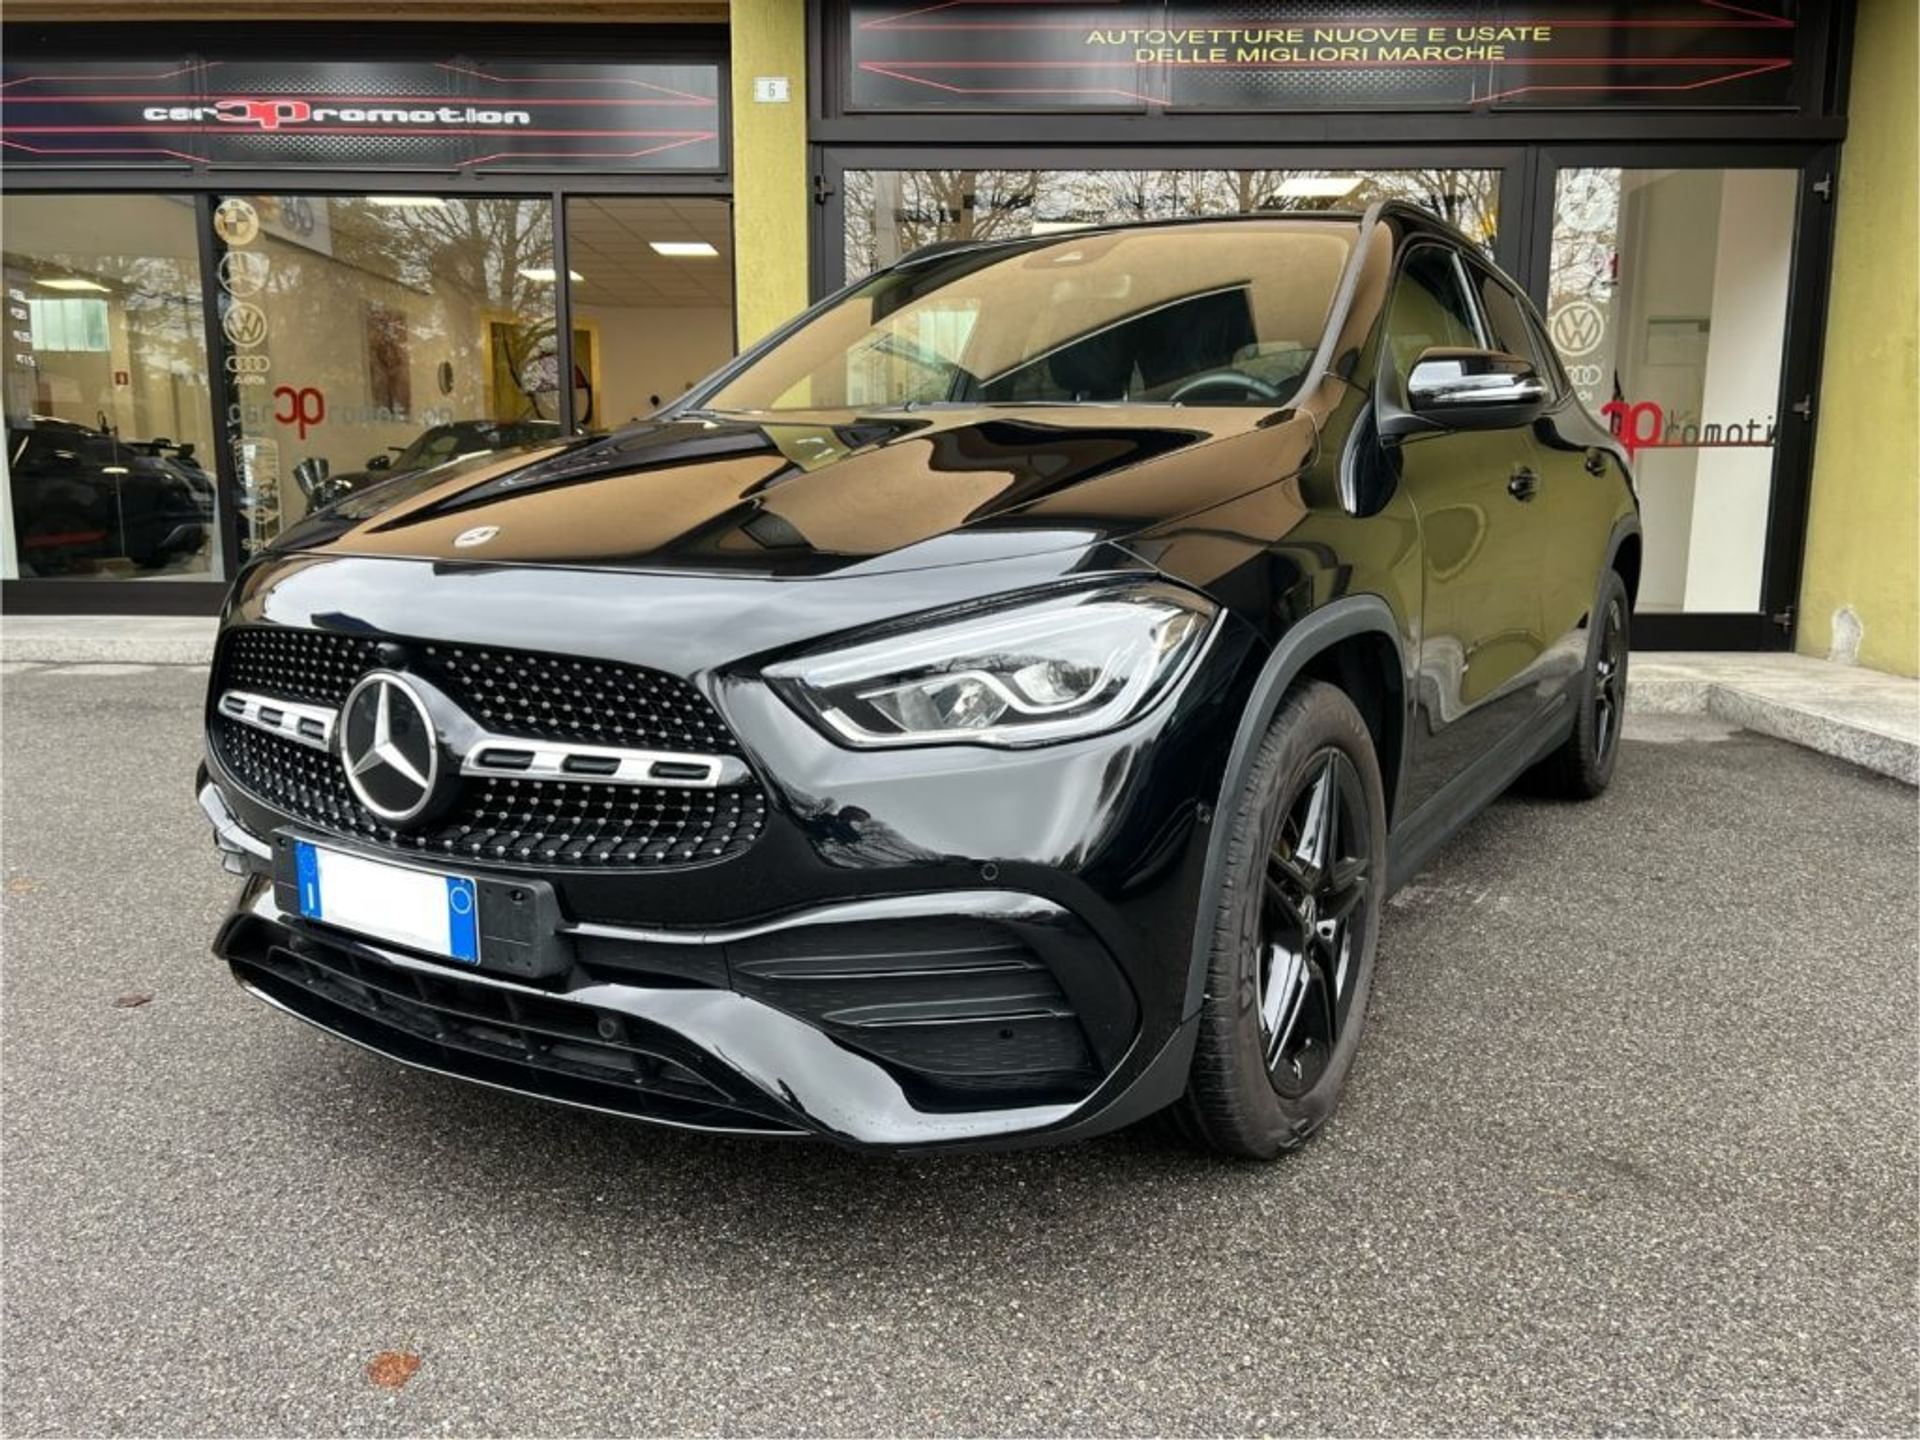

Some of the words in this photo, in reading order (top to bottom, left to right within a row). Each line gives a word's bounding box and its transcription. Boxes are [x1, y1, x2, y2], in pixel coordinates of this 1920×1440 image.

[1086, 29, 1304, 45] AUTOVETTURE
[1313, 27, 1418, 43] NUOVE
[1428, 27, 1447, 42] E
[1456, 26, 1551, 42] USATE
[1135, 48, 1227, 63] DELLE
[1236, 48, 1368, 62] MIGLIORI
[1378, 45, 1505, 61] MARCHE
[768, 82, 776, 97] 6
